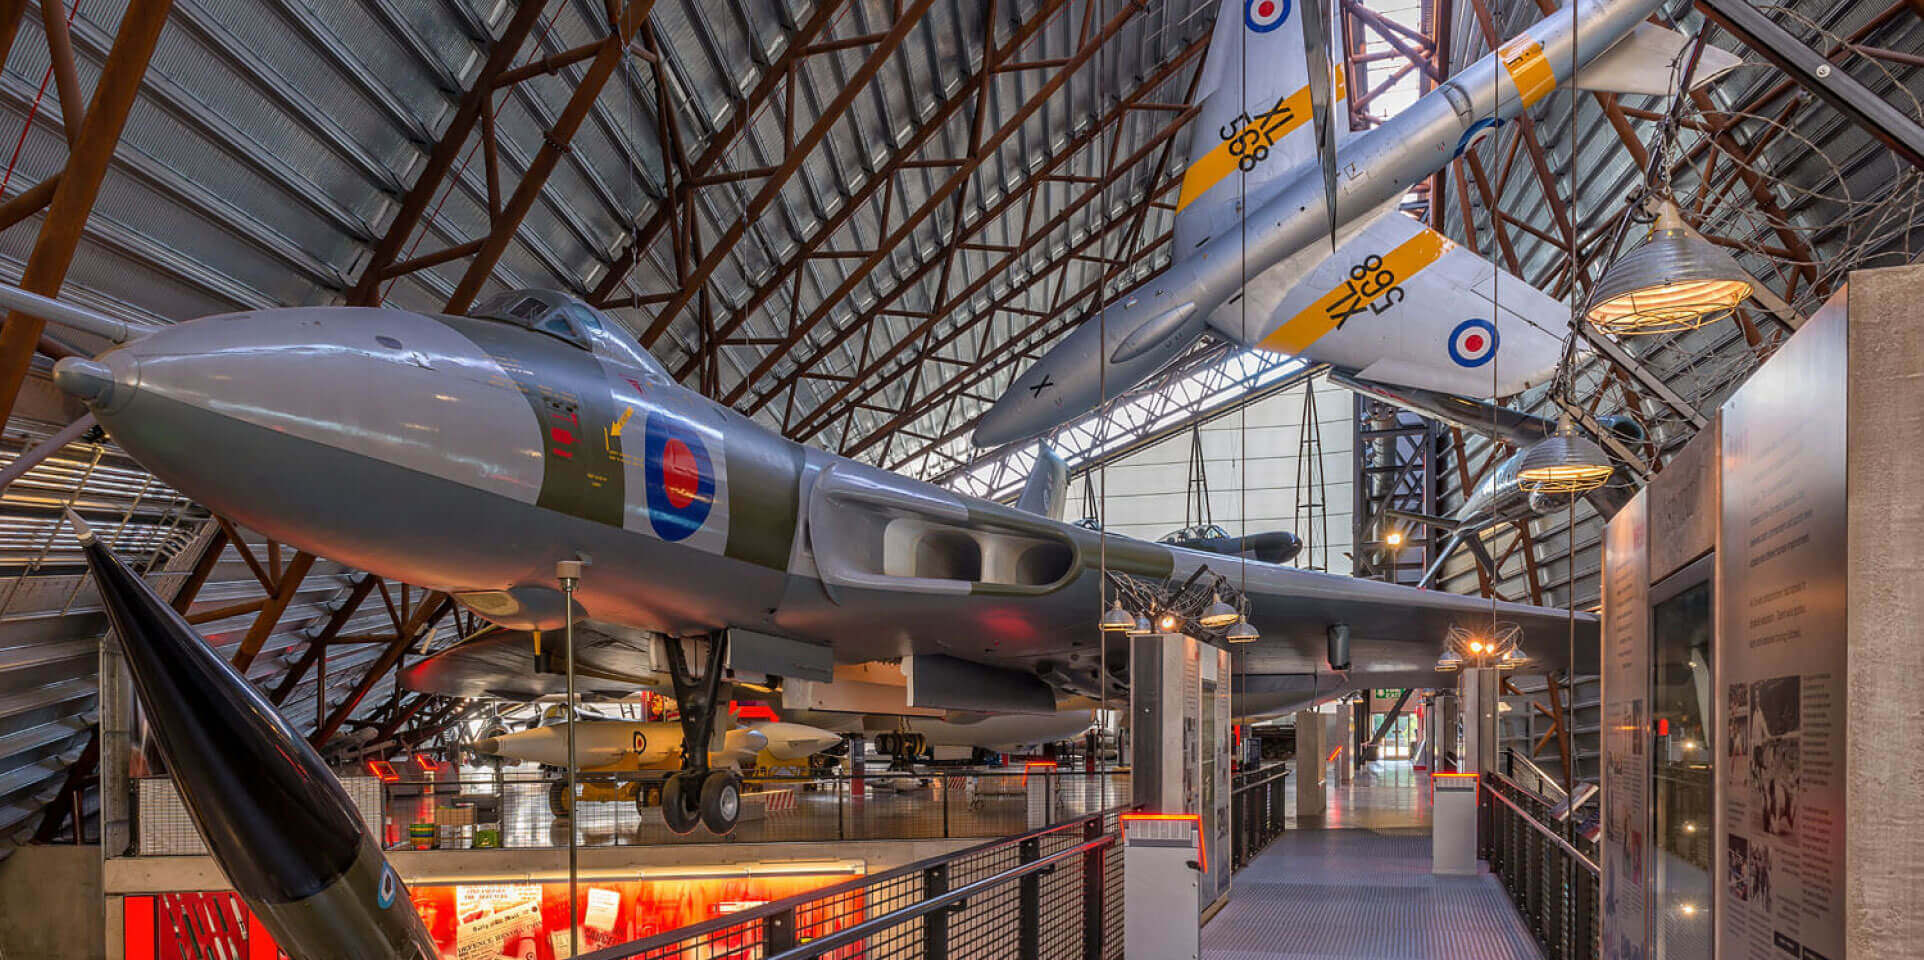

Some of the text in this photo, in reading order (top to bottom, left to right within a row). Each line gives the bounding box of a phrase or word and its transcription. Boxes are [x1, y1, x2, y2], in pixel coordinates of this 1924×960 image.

[1219, 111, 1269, 173] 568
[1254, 95, 1294, 146] XL
[1325, 280, 1368, 331] XL
[1350, 254, 1405, 316] 568
